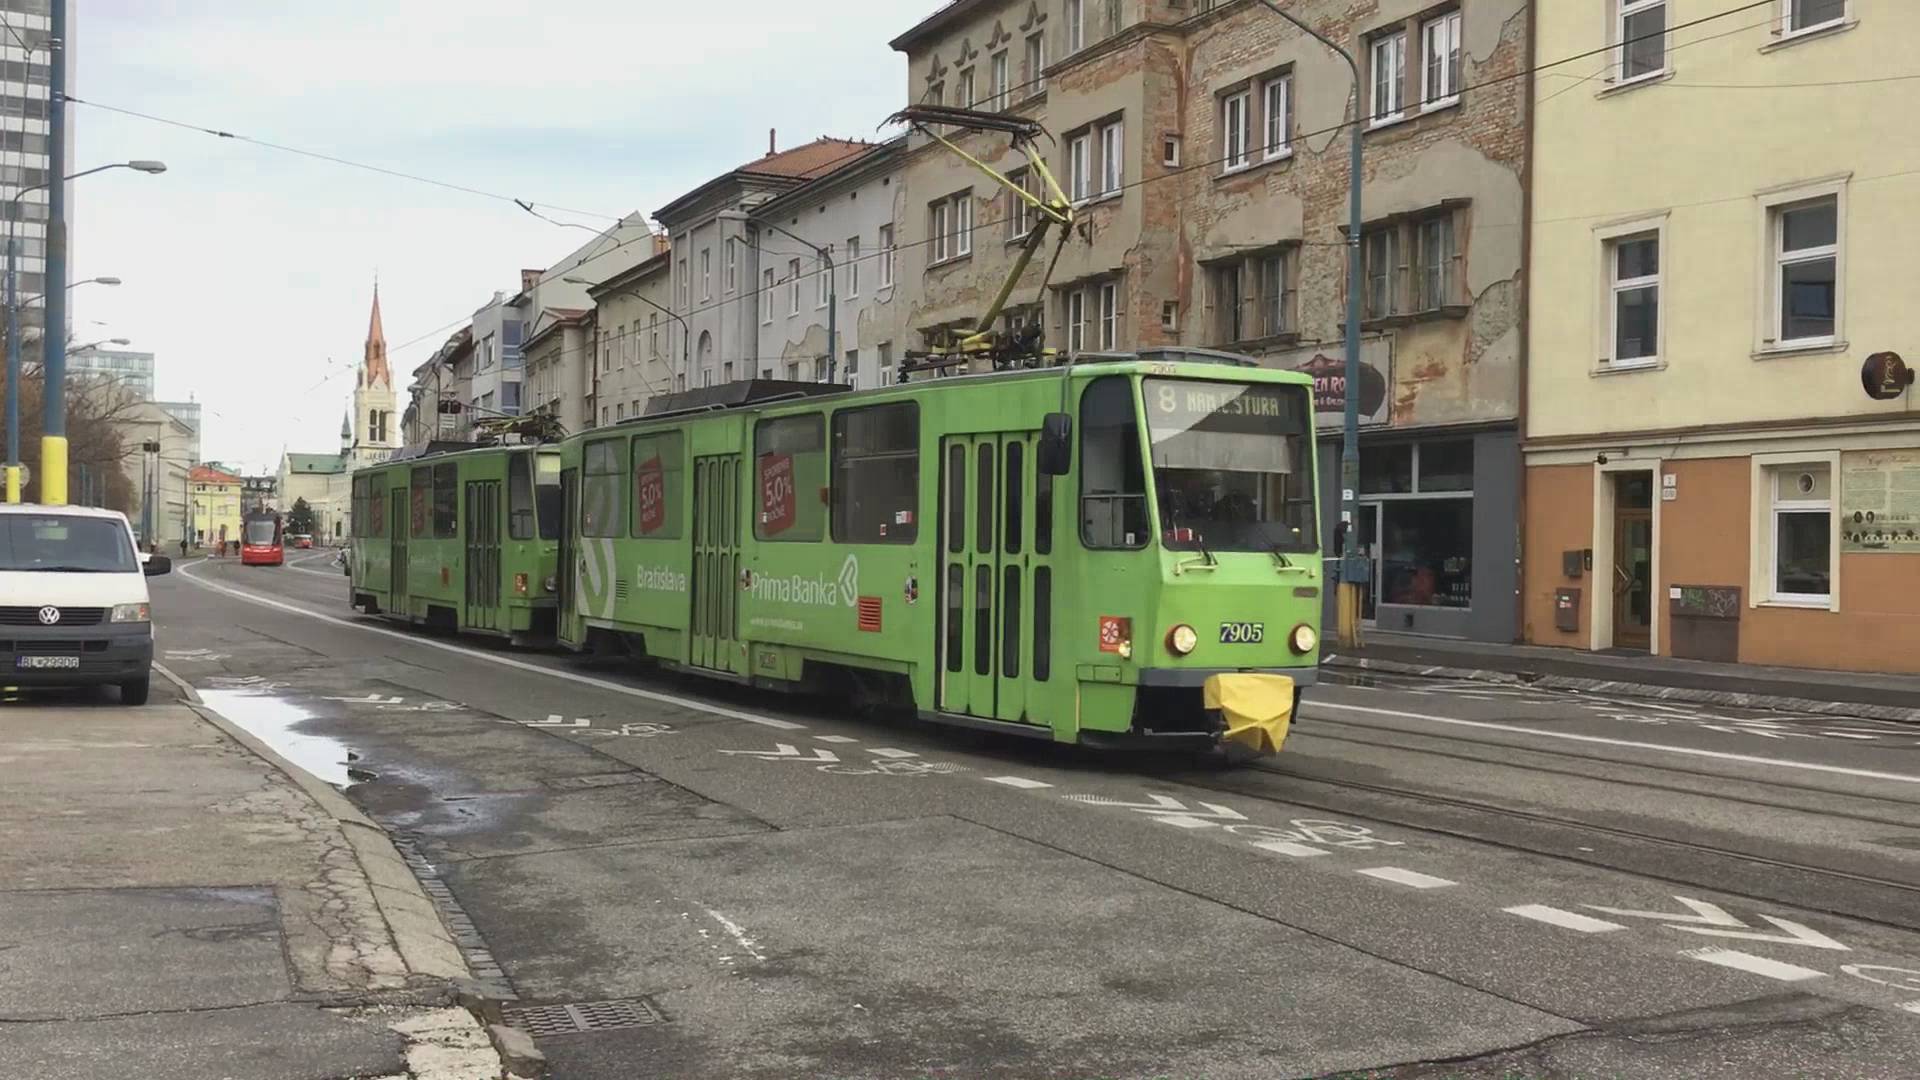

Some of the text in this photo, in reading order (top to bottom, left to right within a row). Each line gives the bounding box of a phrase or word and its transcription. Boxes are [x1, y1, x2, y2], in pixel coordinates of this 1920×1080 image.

[1159, 385, 1176, 413] 8
[637, 565, 686, 592] Bratislava
[1220, 623, 1263, 642] 7905
